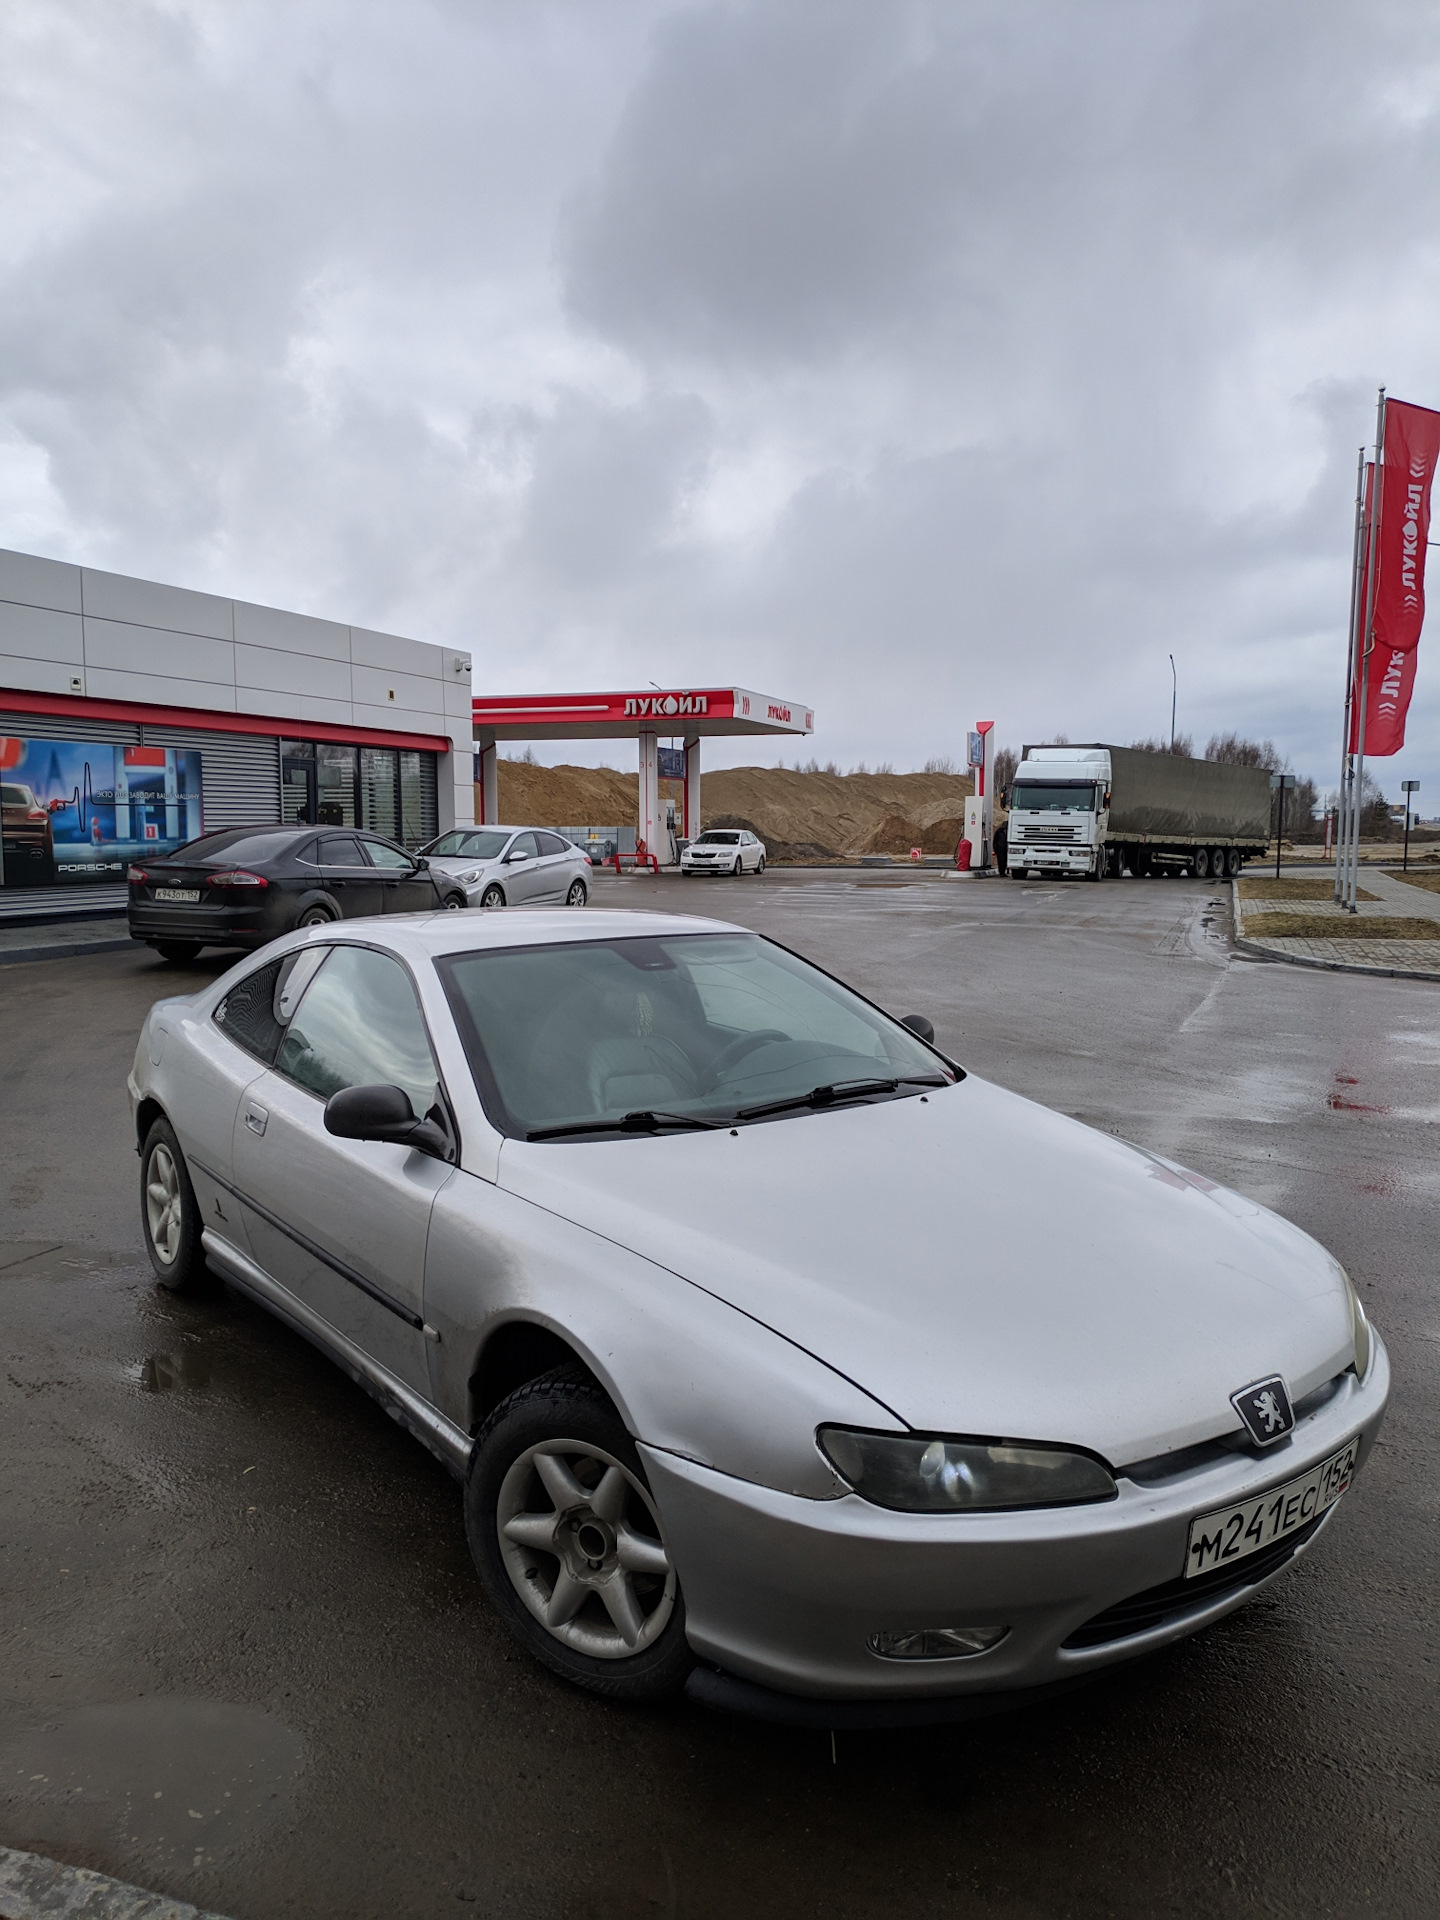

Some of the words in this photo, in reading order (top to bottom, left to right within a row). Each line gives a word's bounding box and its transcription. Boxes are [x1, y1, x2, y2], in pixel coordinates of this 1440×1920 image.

[1401, 484, 1423, 590] ЛУКОЙЛ
[1380, 649, 1405, 698] ЛУК
[623, 690, 708, 715] ЛУКОЙЛ
[97, 790, 113, 798] ЭКТО
[114, 791, 127, 799] PLUS
[129, 791, 155, 800] ЗАВОДИТ
[58, 863, 122, 872] PORSCHE
[1197, 1486, 1317, 1568] М241ЕС
[1322, 1449, 1353, 1493] 152
